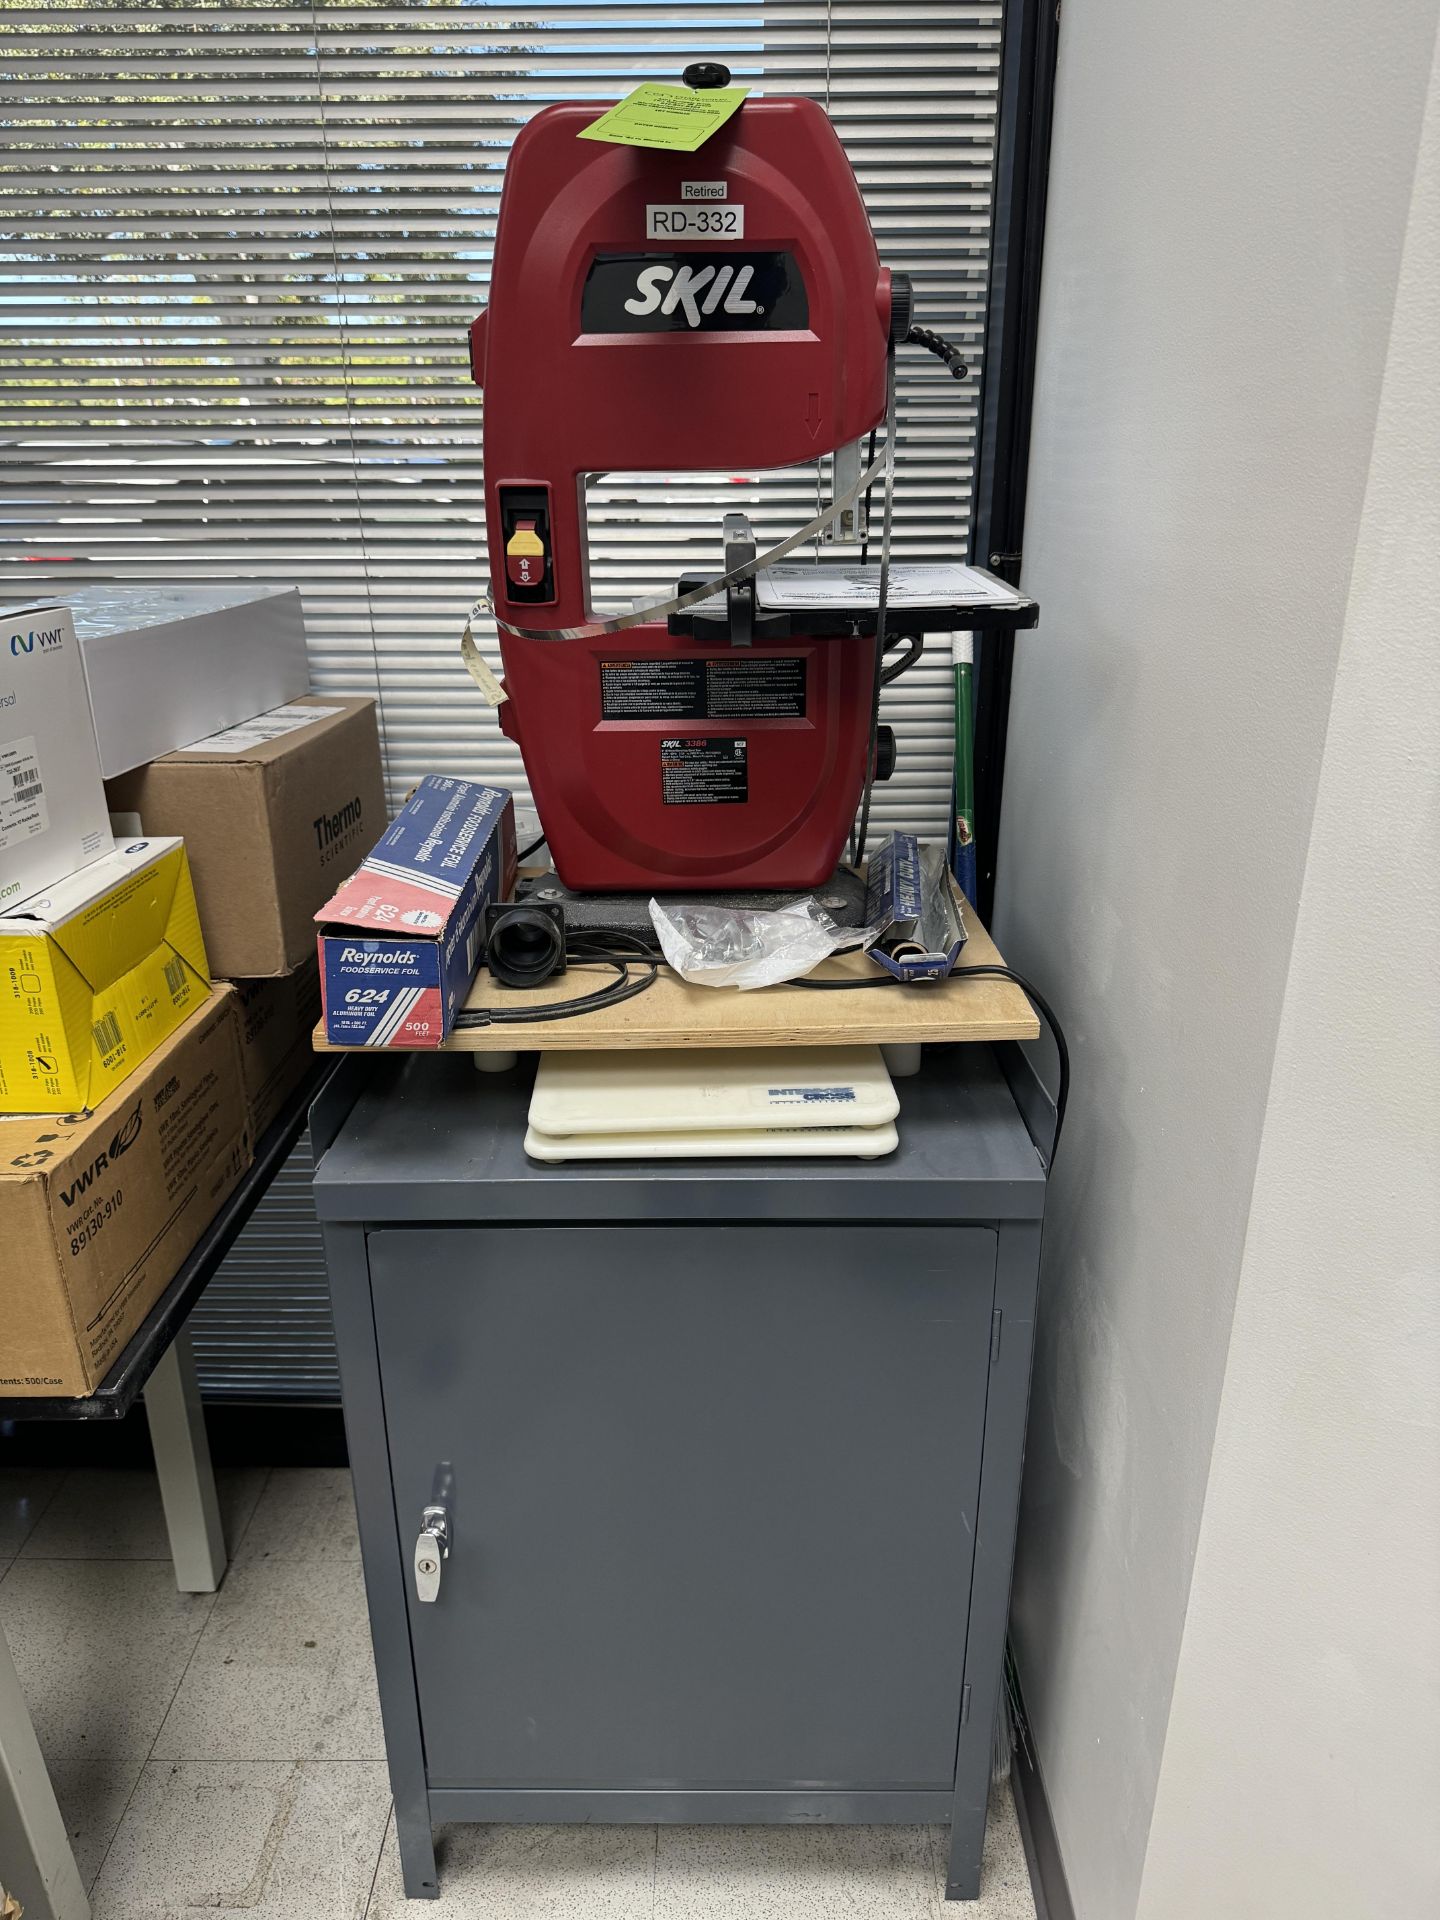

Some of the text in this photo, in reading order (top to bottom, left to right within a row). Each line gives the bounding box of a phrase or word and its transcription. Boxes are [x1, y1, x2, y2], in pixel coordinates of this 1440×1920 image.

[685, 185, 724, 198] Retired
[653, 211, 737, 232] RD-332
[624, 265, 757, 327] SKIL
[661, 740, 681, 749] SKIL
[314, 797, 362, 850] Thermo
[440, 787, 503, 868] Reynolds FOODSERVICE FOIL
[321, 822, 364, 867] SCIENTIFIC
[414, 837, 443, 862] Reynolds
[900, 857, 914, 879] DUTY
[899, 879, 916, 907] HEAVY
[372, 904, 400, 923] 624
[340, 947, 416, 966] Reynolds
[340, 966, 420, 976] FOODSERVICE FOIL
[345, 988, 390, 1004] 624
[405, 1022, 429, 1031] 500
[59, 1152, 109, 1208] VWR
[66, 1216, 83, 1236] VWR
[83, 1207, 95, 1222] Cat.
[70, 1189, 123, 1256] 89130-910
[0, 1377, 63, 1385] tents: 500/Case
